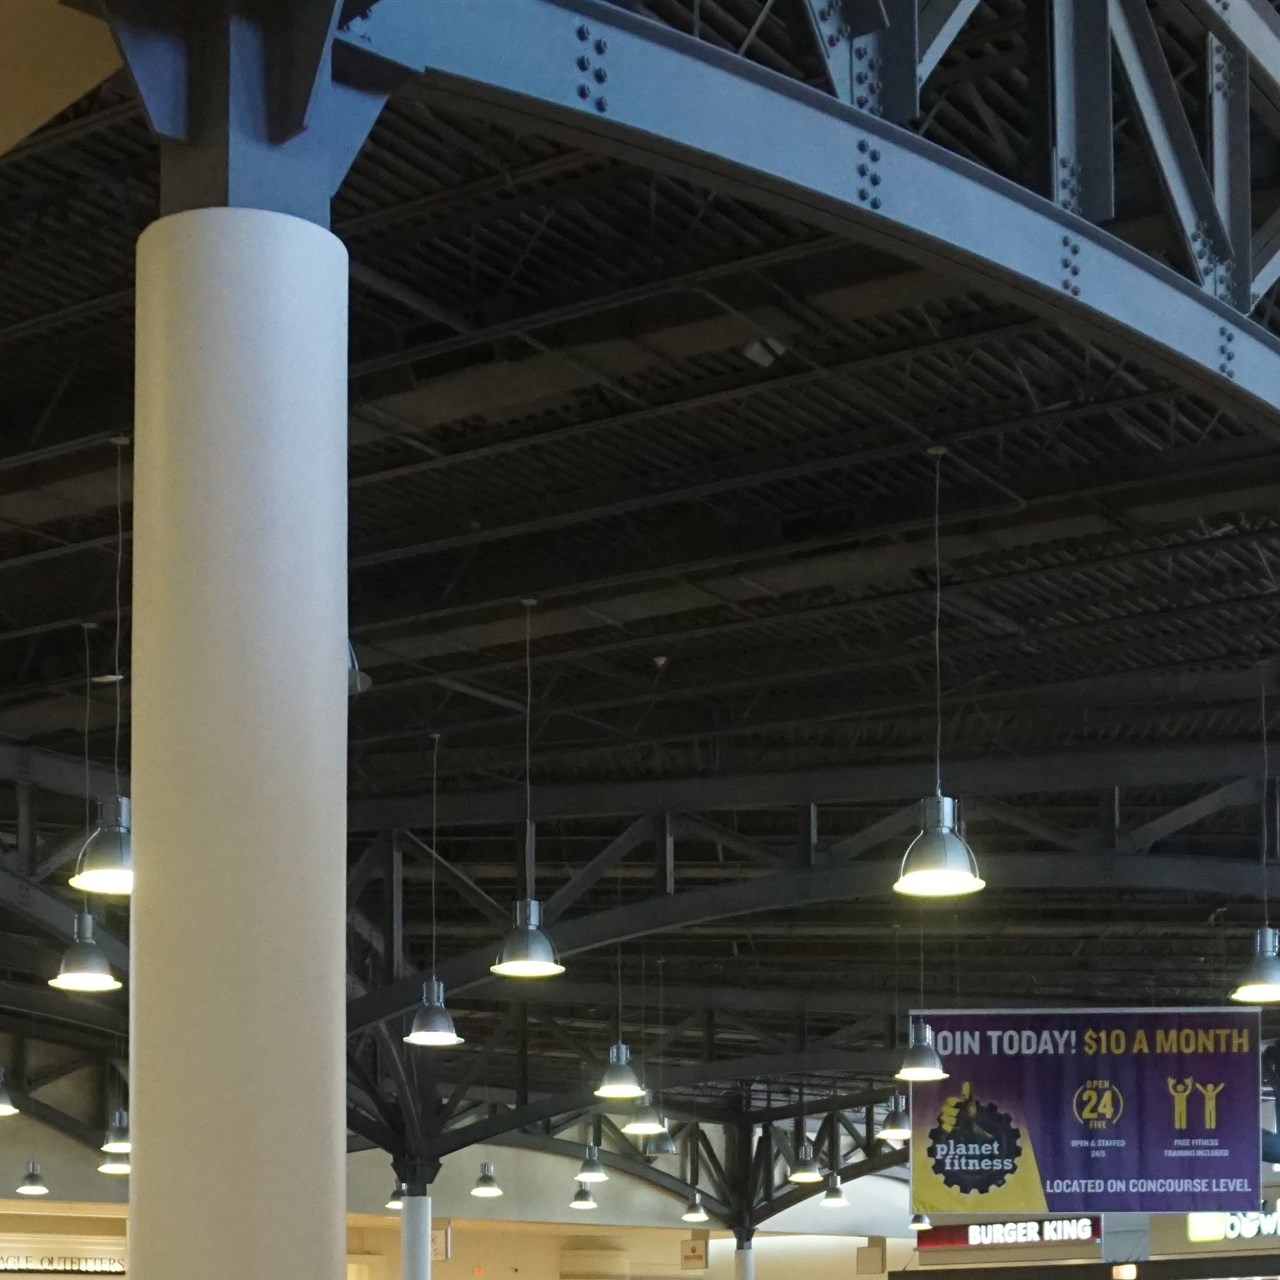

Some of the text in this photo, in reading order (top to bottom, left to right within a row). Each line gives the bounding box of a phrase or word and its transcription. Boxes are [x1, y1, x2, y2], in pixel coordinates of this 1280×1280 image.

[932, 1028, 1250, 1056] OIN TODAY! $10 A MONTH
[1087, 1080, 1110, 1089] OPEN
[1082, 1089, 1114, 1119] 24
[1089, 1120, 1107, 1129] FIVE
[935, 1140, 1000, 1159] planet
[945, 1155, 1013, 1170] fitness
[1046, 1178, 1252, 1193] LOCATED ON CONCOURSE LEVEL
[968, 1218, 1092, 1245] BURGER KING
[39, 1256, 126, 1270] OUTFITTERS
